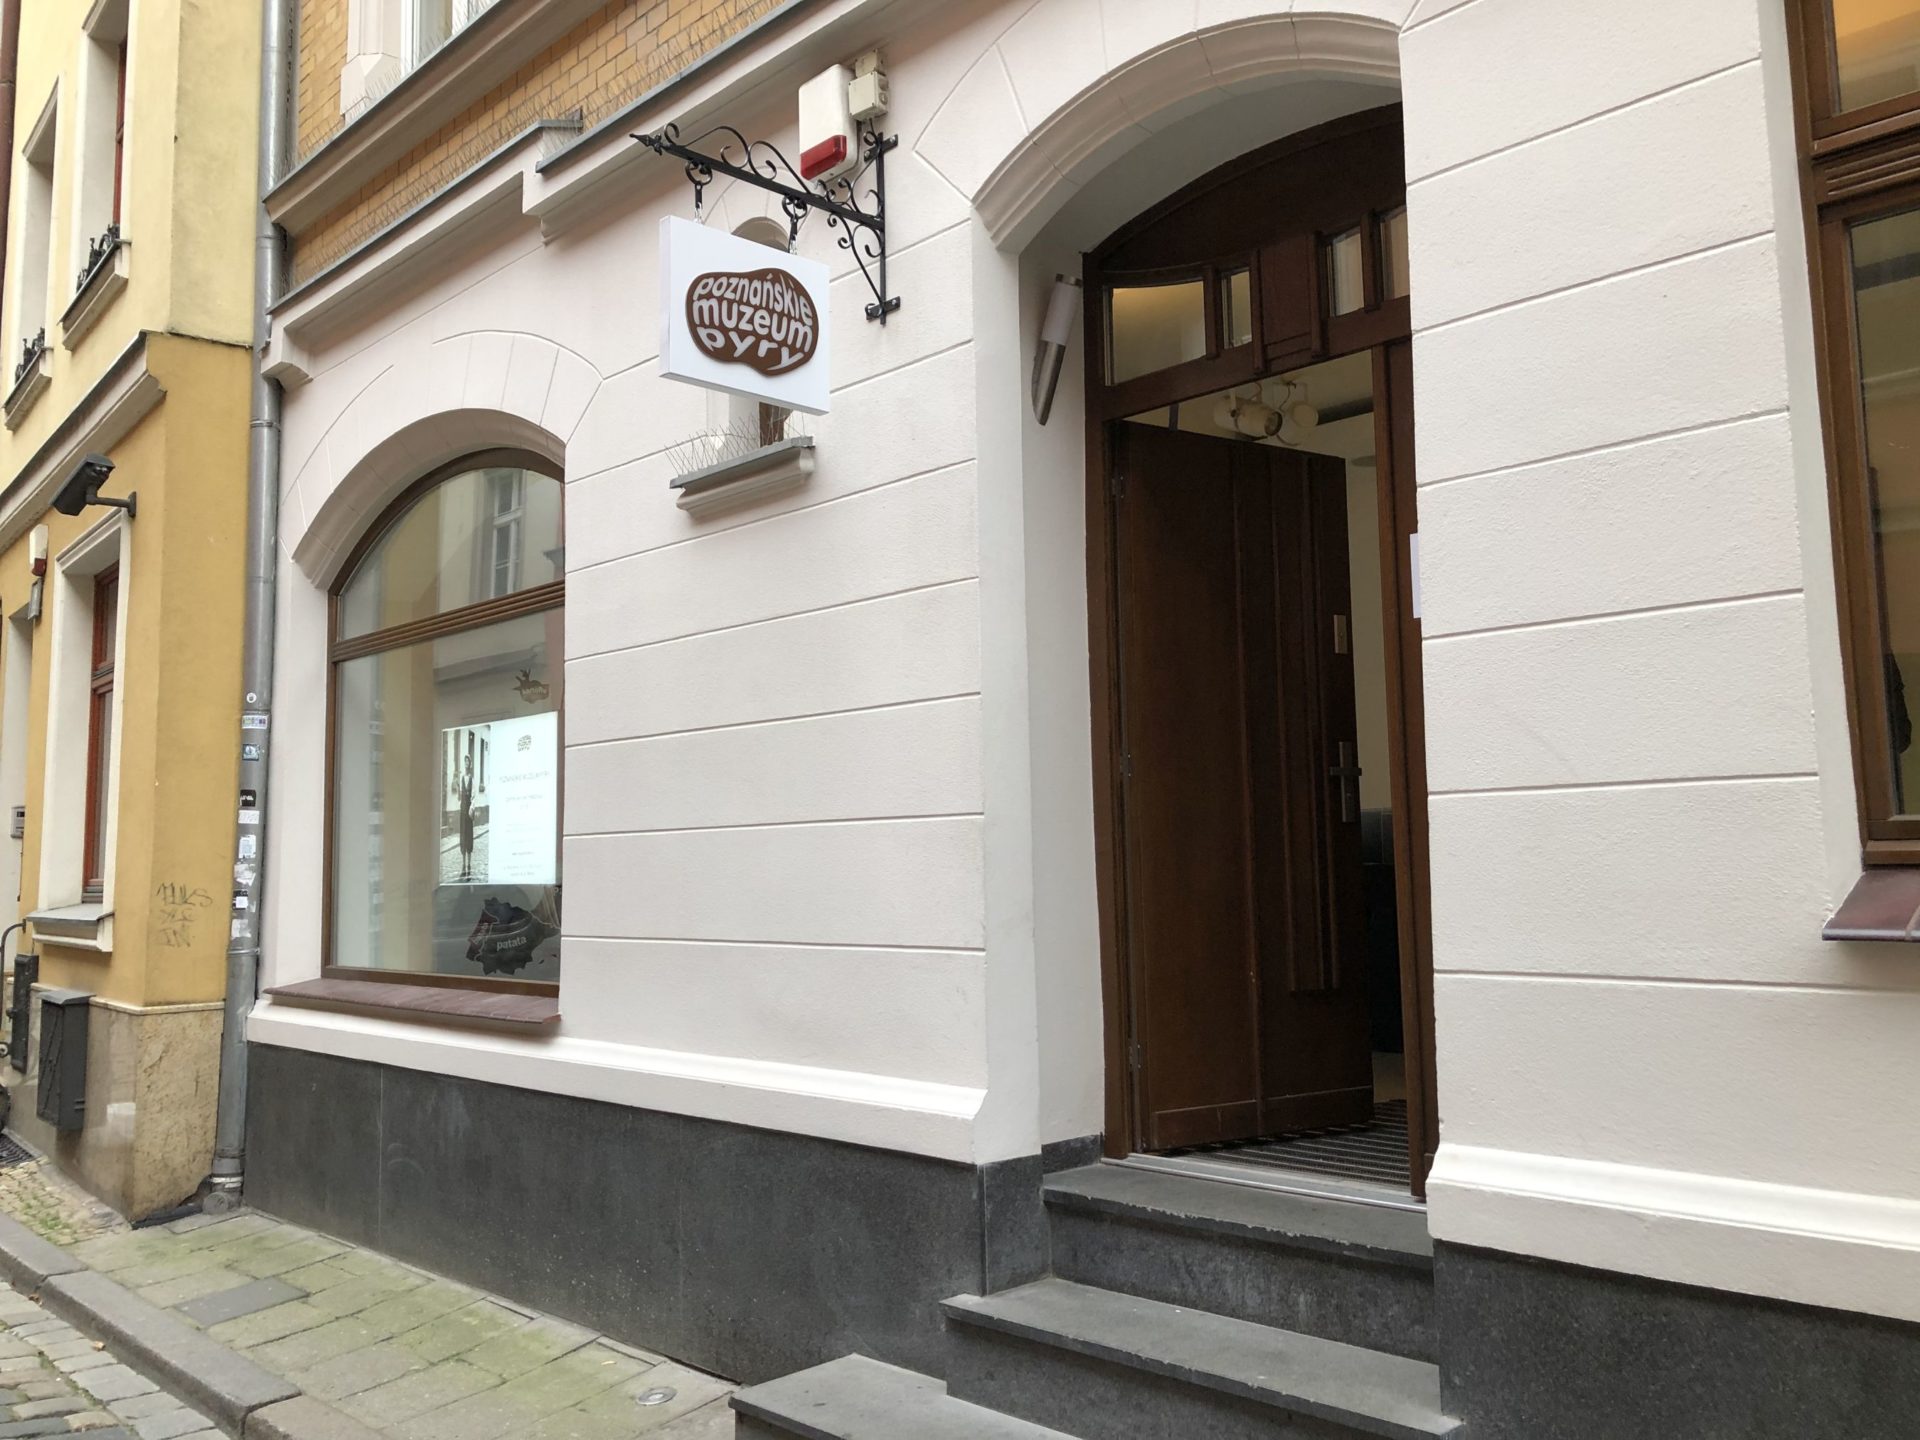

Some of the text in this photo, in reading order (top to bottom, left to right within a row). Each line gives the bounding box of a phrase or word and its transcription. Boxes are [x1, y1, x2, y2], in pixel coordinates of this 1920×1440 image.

[693, 272, 813, 326] poznańskie
[693, 298, 813, 353] muzeum
[696, 326, 805, 371] pyry
[496, 936, 527, 952] patata
